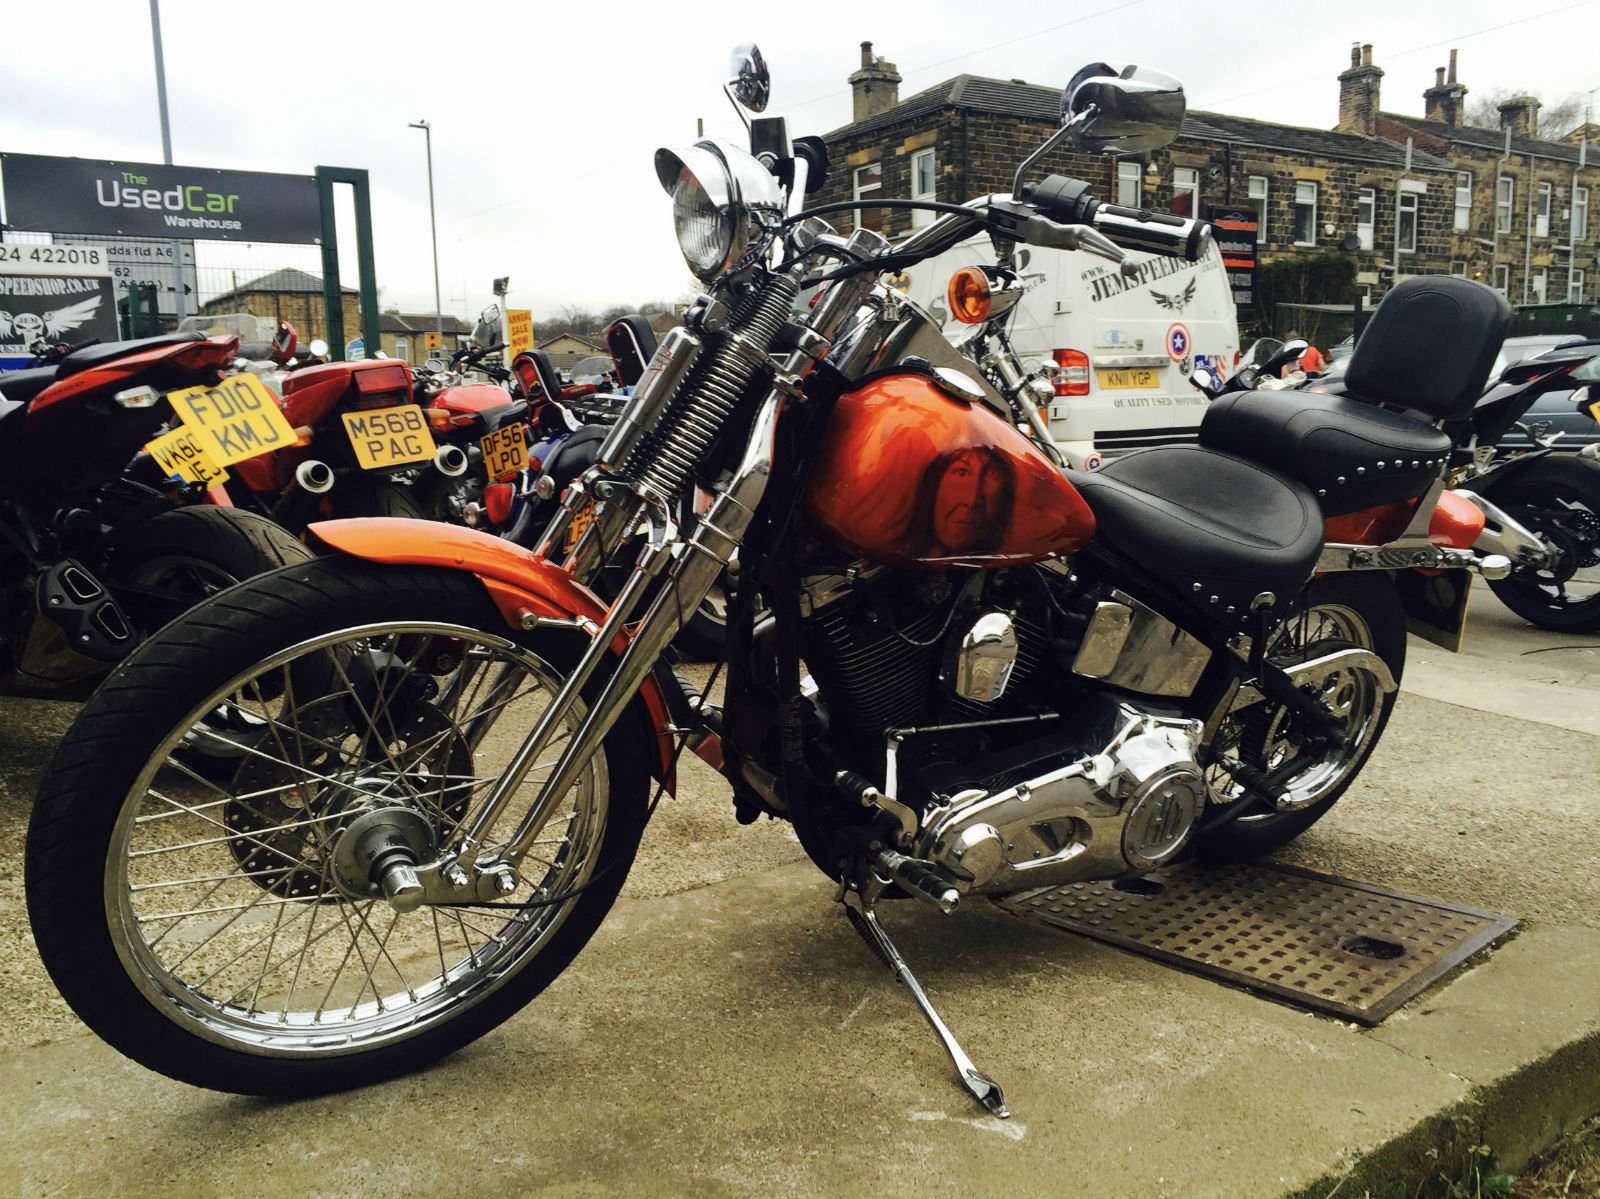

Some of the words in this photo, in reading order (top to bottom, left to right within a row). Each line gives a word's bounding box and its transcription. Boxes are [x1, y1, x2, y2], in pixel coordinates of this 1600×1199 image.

[121, 172, 148, 185] The
[96, 179, 240, 213] UsedCar
[163, 215, 242, 230] Warehouse
[30, 247, 100, 265] 422018
[512, 324, 529, 336] SALE
[512, 336, 529, 347] NOW
[1132, 371, 1152, 385] YGP
[1113, 398, 1150, 408] QUALITY
[1151, 397, 1173, 407] USED
[349, 410, 422, 439] M568
[211, 414, 280, 457] KMJ
[482, 424, 522, 457] DF56
[367, 435, 423, 462] PAG
[491, 447, 522, 474] LPO
